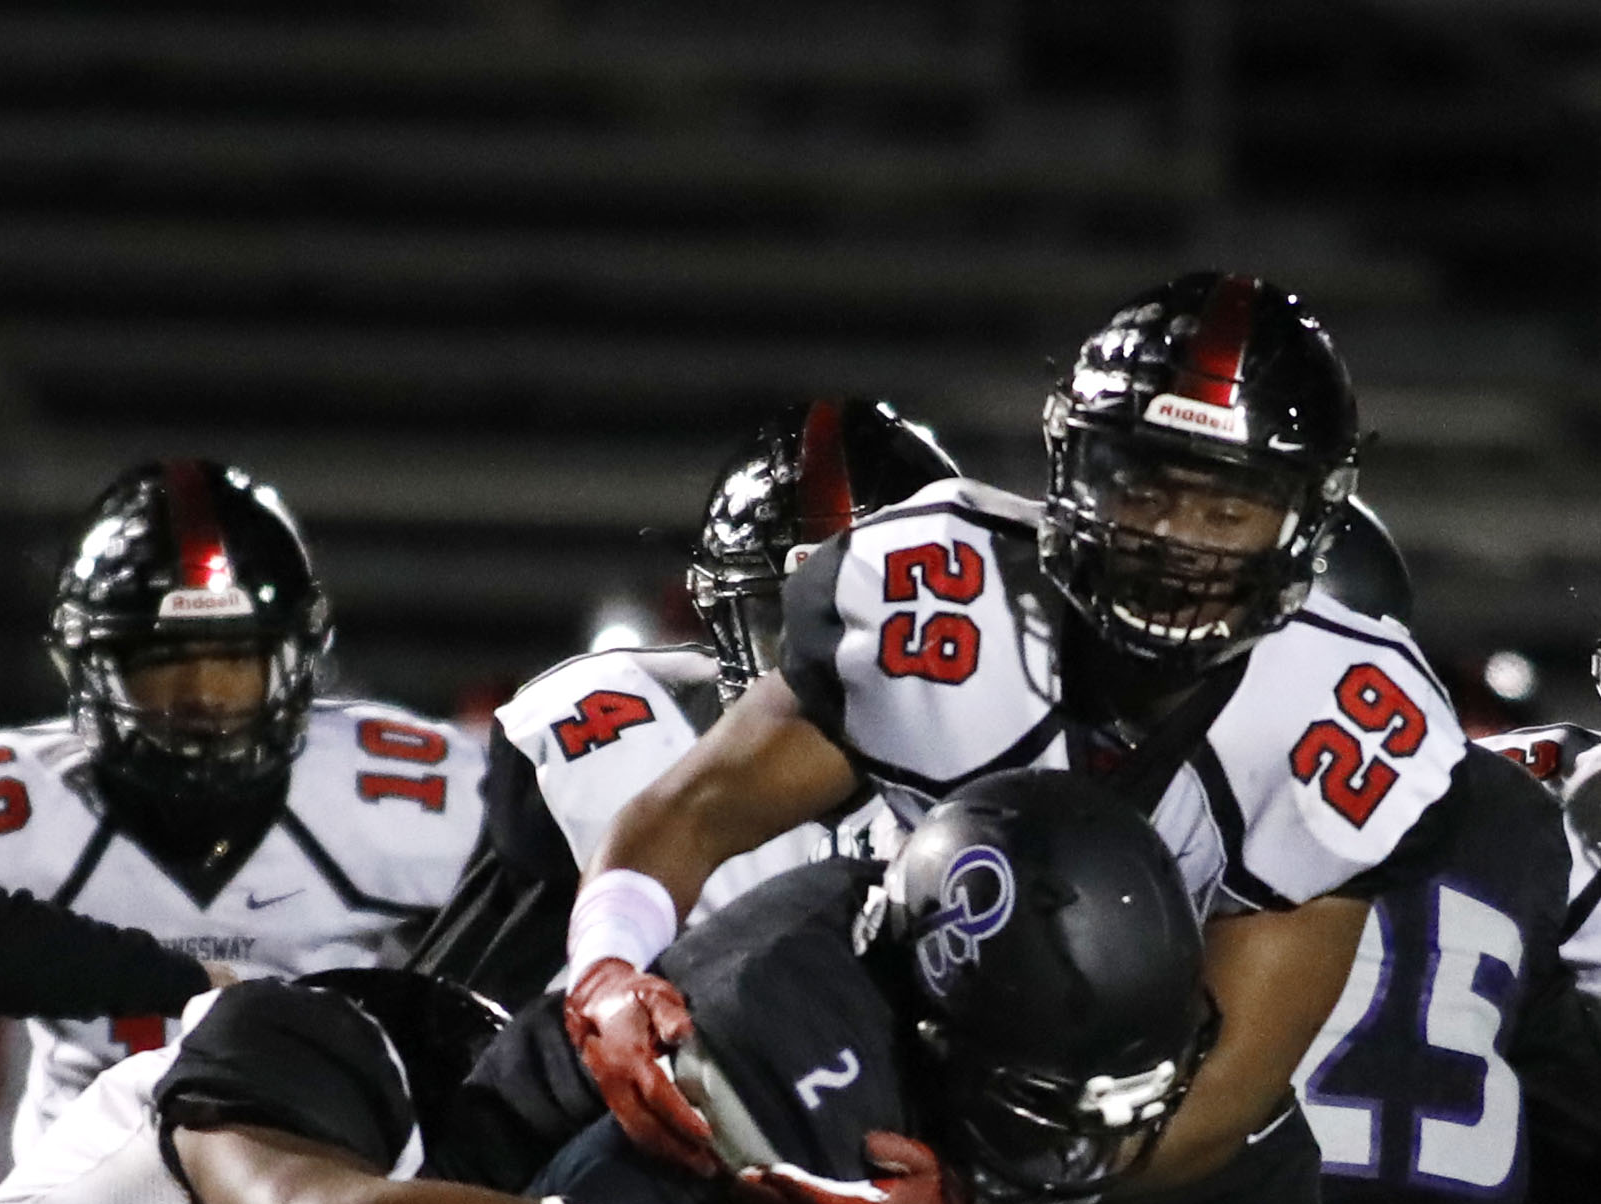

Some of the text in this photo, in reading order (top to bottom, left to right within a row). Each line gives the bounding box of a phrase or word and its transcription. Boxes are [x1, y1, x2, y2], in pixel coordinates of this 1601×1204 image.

[878, 539, 984, 686] 29
[354, 716, 449, 814] 10
[549, 689, 657, 763] 4
[1288, 662, 1428, 829] 29
[793, 1045, 863, 1111] 2
